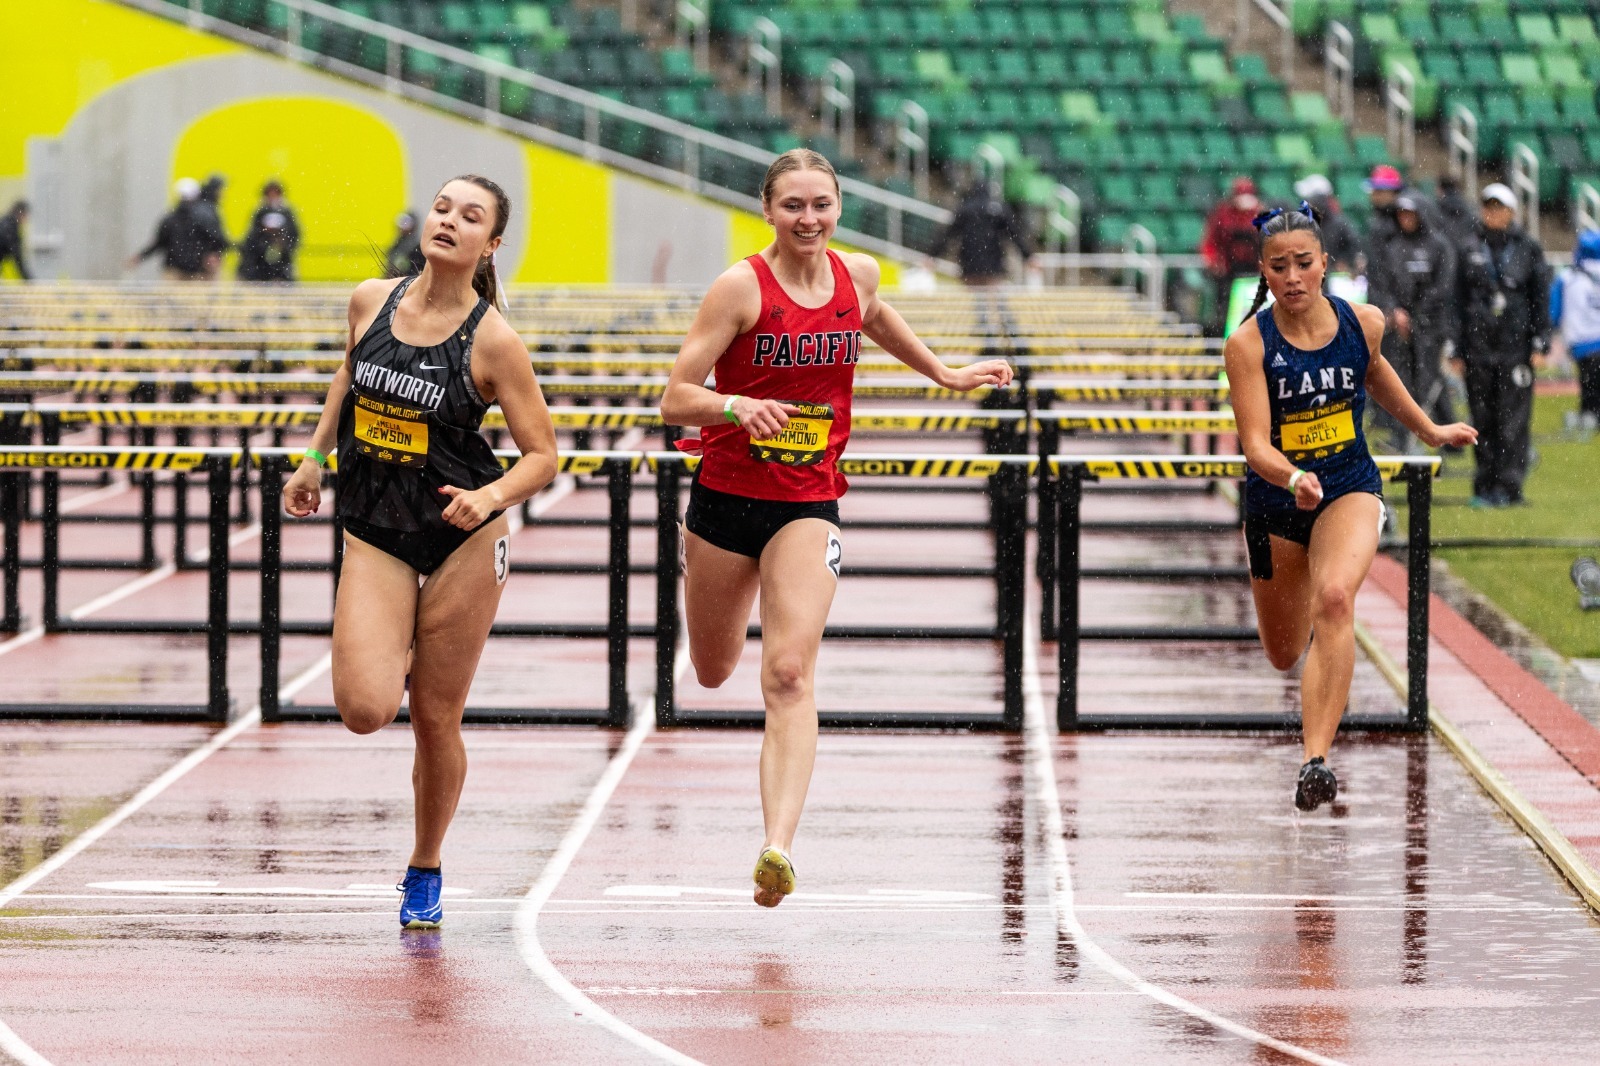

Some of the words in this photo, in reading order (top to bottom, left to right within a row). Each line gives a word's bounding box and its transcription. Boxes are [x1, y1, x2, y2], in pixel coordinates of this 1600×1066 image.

[355, 360, 446, 410] WHITWORTH
[1278, 367, 1355, 399] LANE
[358, 395, 385, 413] OREGON
[387, 404, 422, 420] TWILIGHT
[1285, 411, 1315, 422] OREGON
[1317, 402, 1347, 418] TWILIGHT
[366, 424, 412, 446] HEWSON
[376, 419, 401, 431] AMELIA
[786, 421, 809, 431] LYSON
[1298, 426, 1338, 445] TAPLEY
[770, 430, 819, 446] AMMOND
[498, 539, 506, 581] 3
